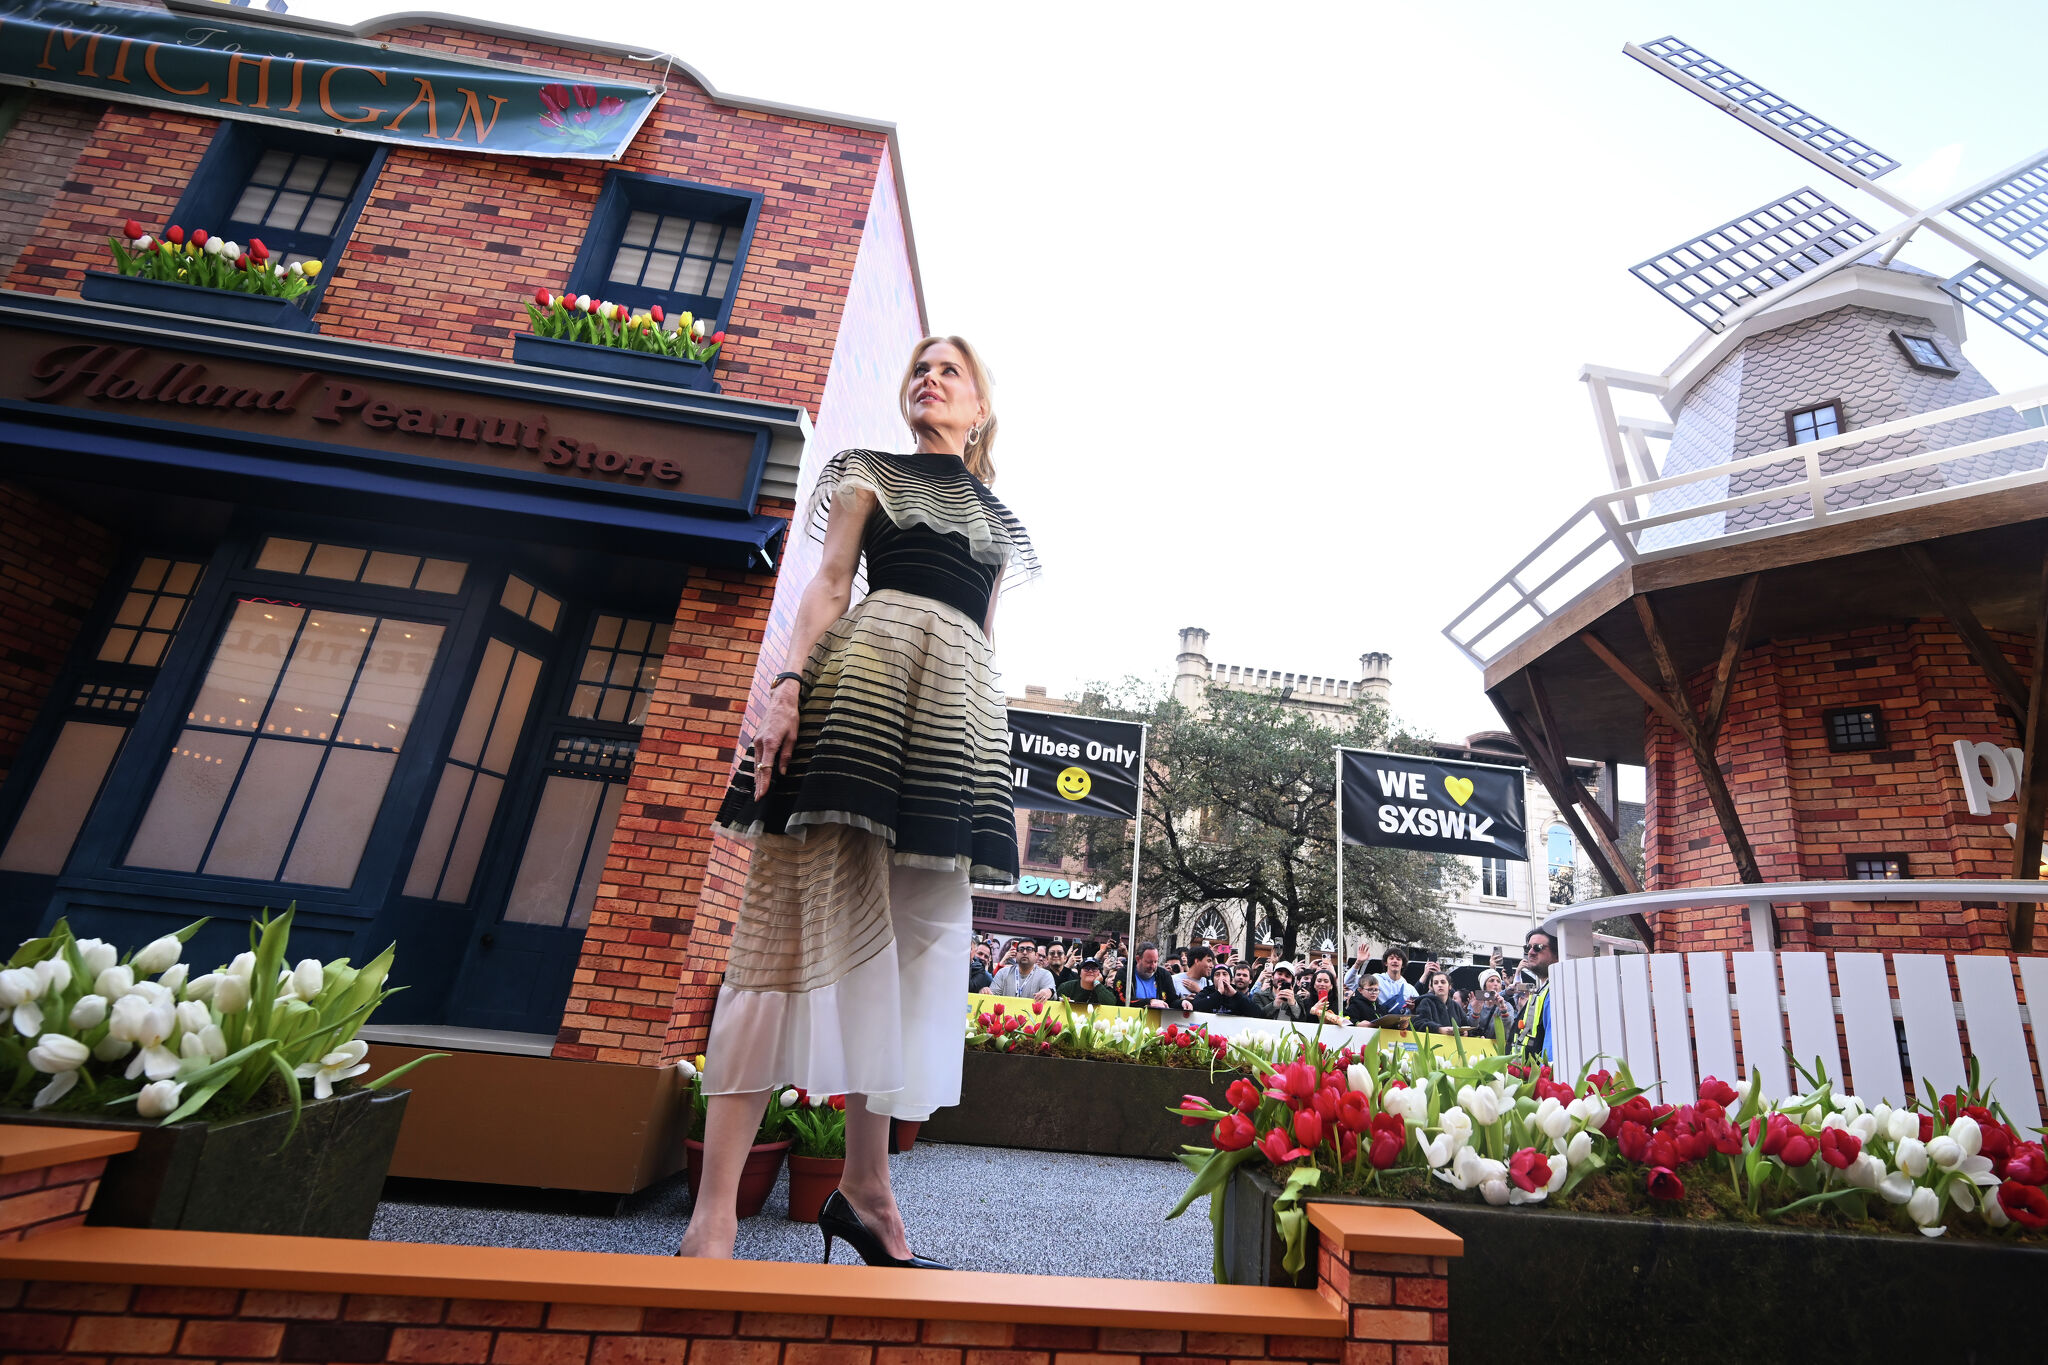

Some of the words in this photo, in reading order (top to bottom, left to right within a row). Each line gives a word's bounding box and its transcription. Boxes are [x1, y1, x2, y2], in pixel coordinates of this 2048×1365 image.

[37, 28, 508, 145] MICHIGAN
[25, 344, 323, 413] Holland
[312, 380, 549, 449] Peanut
[1020, 733, 1080, 759] Vibes
[1087, 741, 1136, 768] Only
[1376, 769, 1428, 800] WE
[1378, 804, 1466, 840] SXSW
